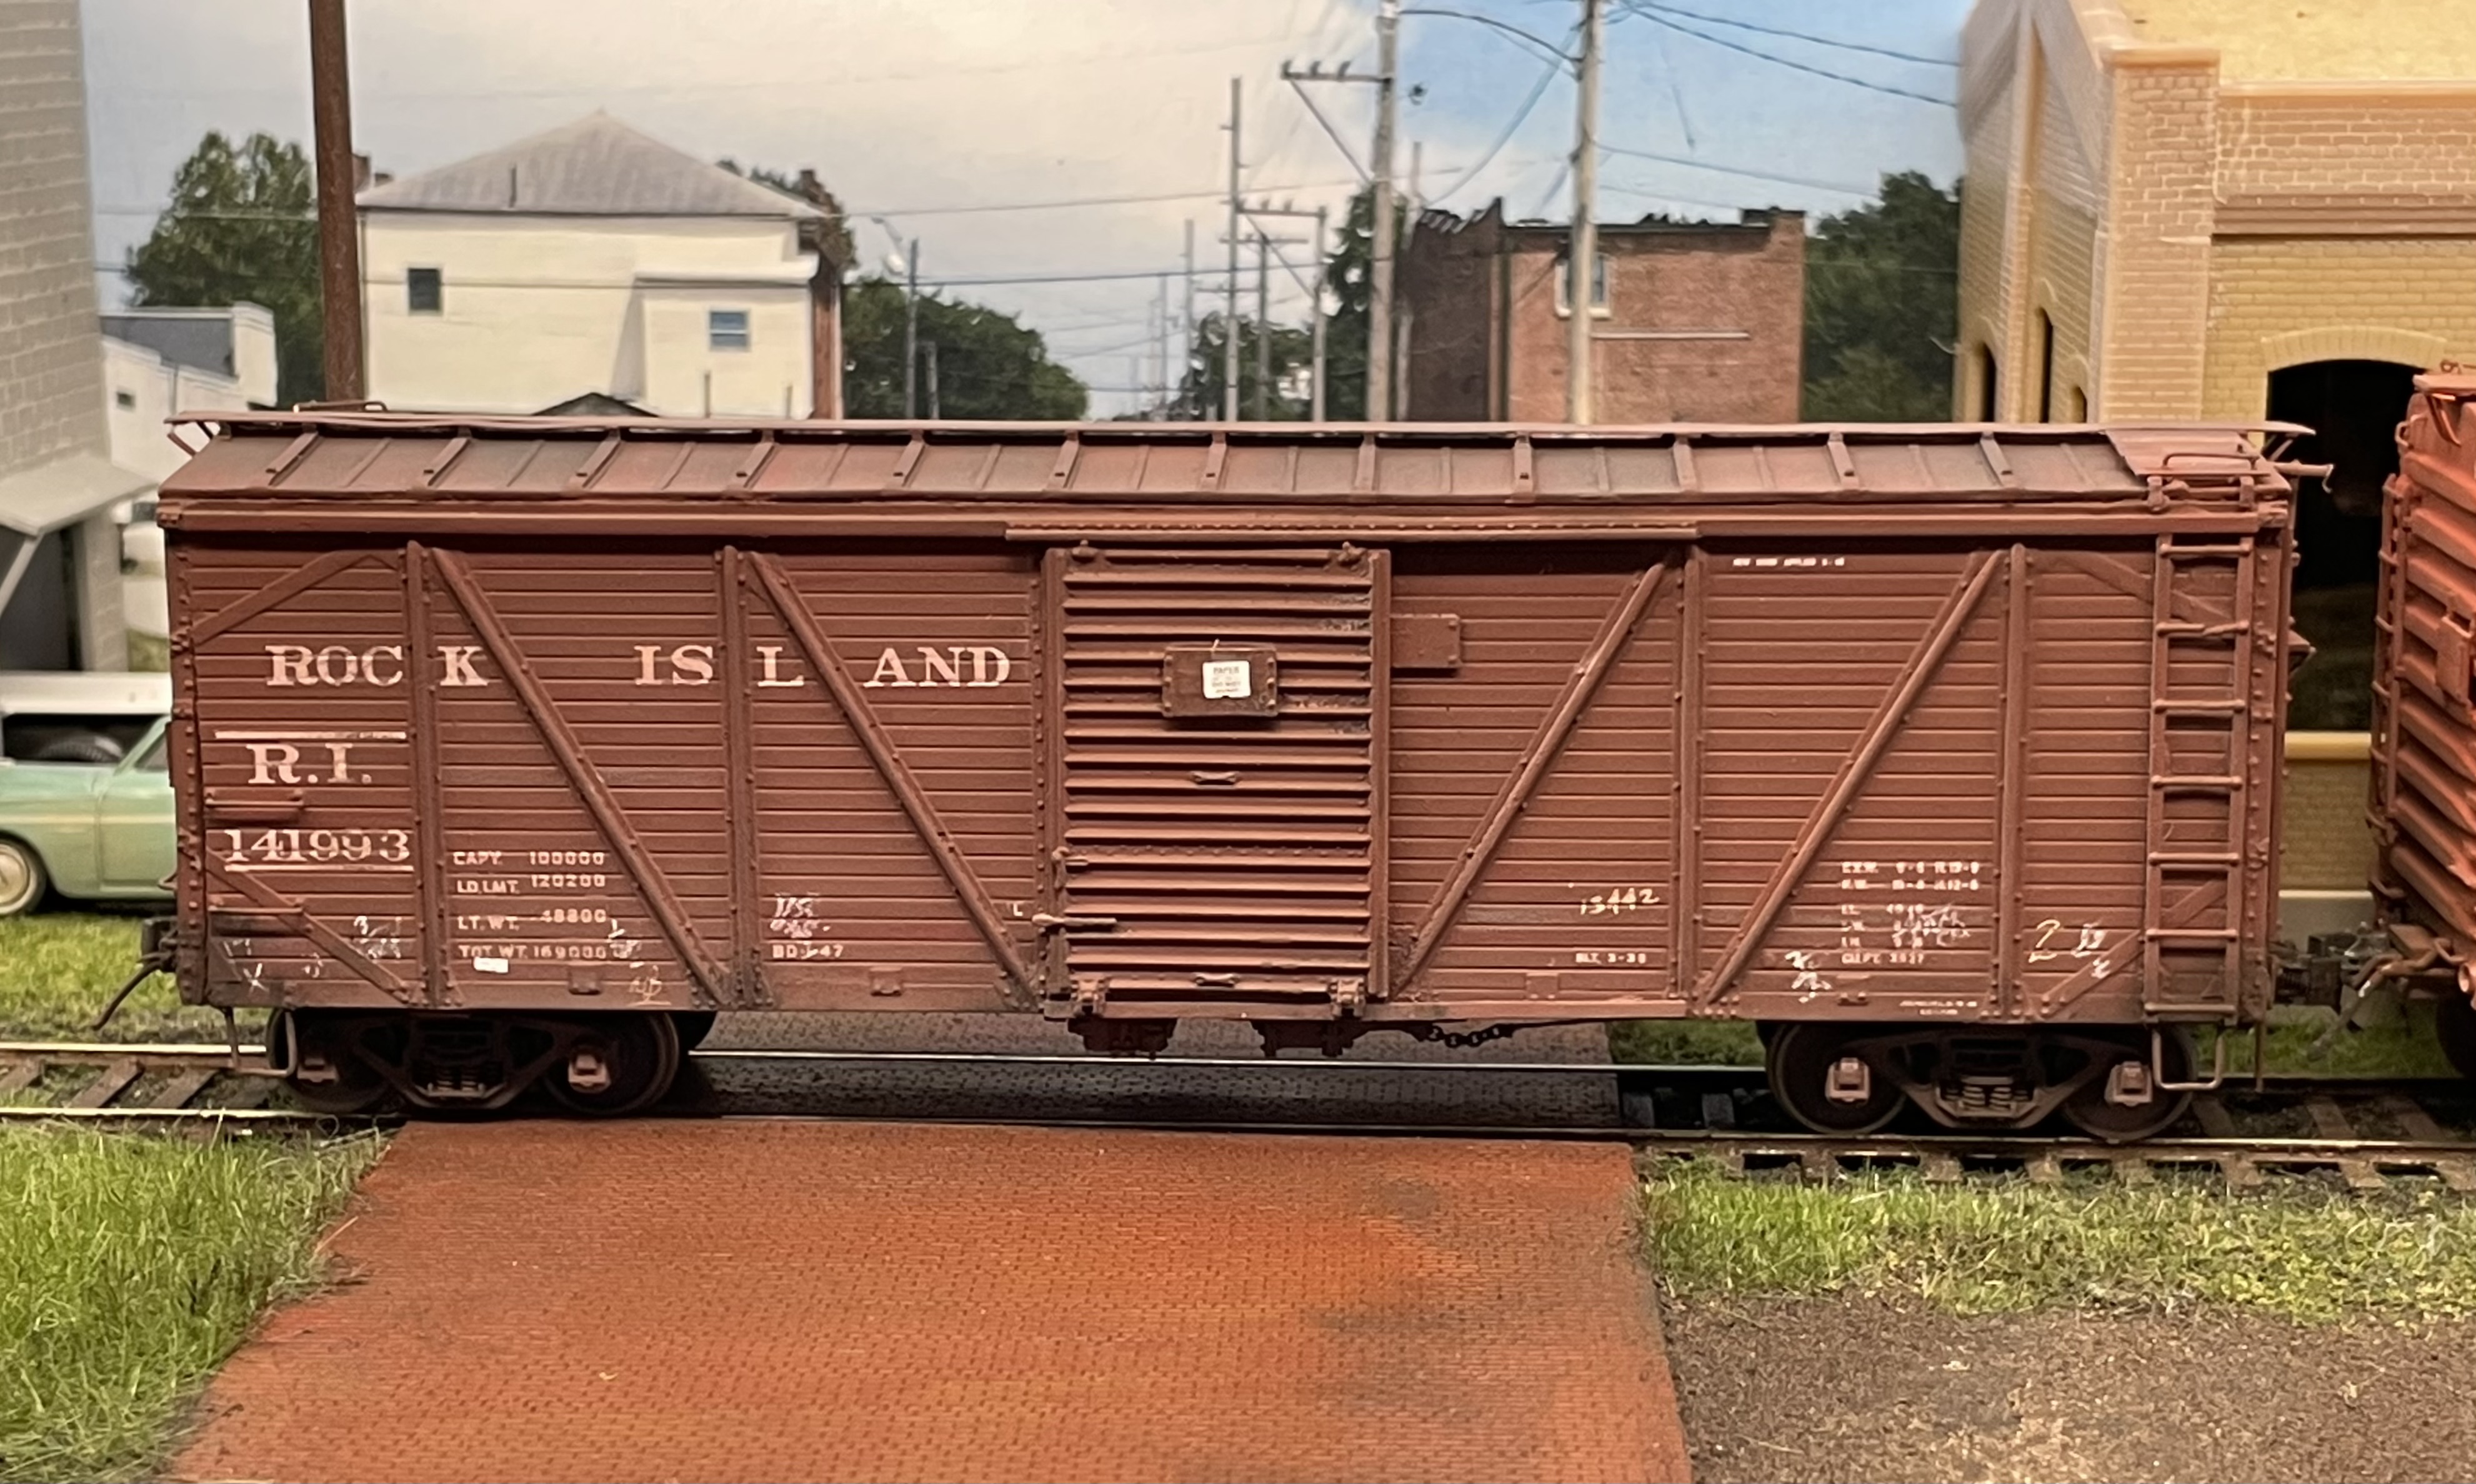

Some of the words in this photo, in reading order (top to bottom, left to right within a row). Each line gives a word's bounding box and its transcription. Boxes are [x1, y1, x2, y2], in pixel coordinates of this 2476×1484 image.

[246, 743, 373, 785] R.I.
[224, 829, 410, 862] 141993
[530, 851, 604, 865] 100000
[531, 874, 606, 888] 120200
[540, 909, 606, 923] 48800
[534, 946, 606, 959] 169000
